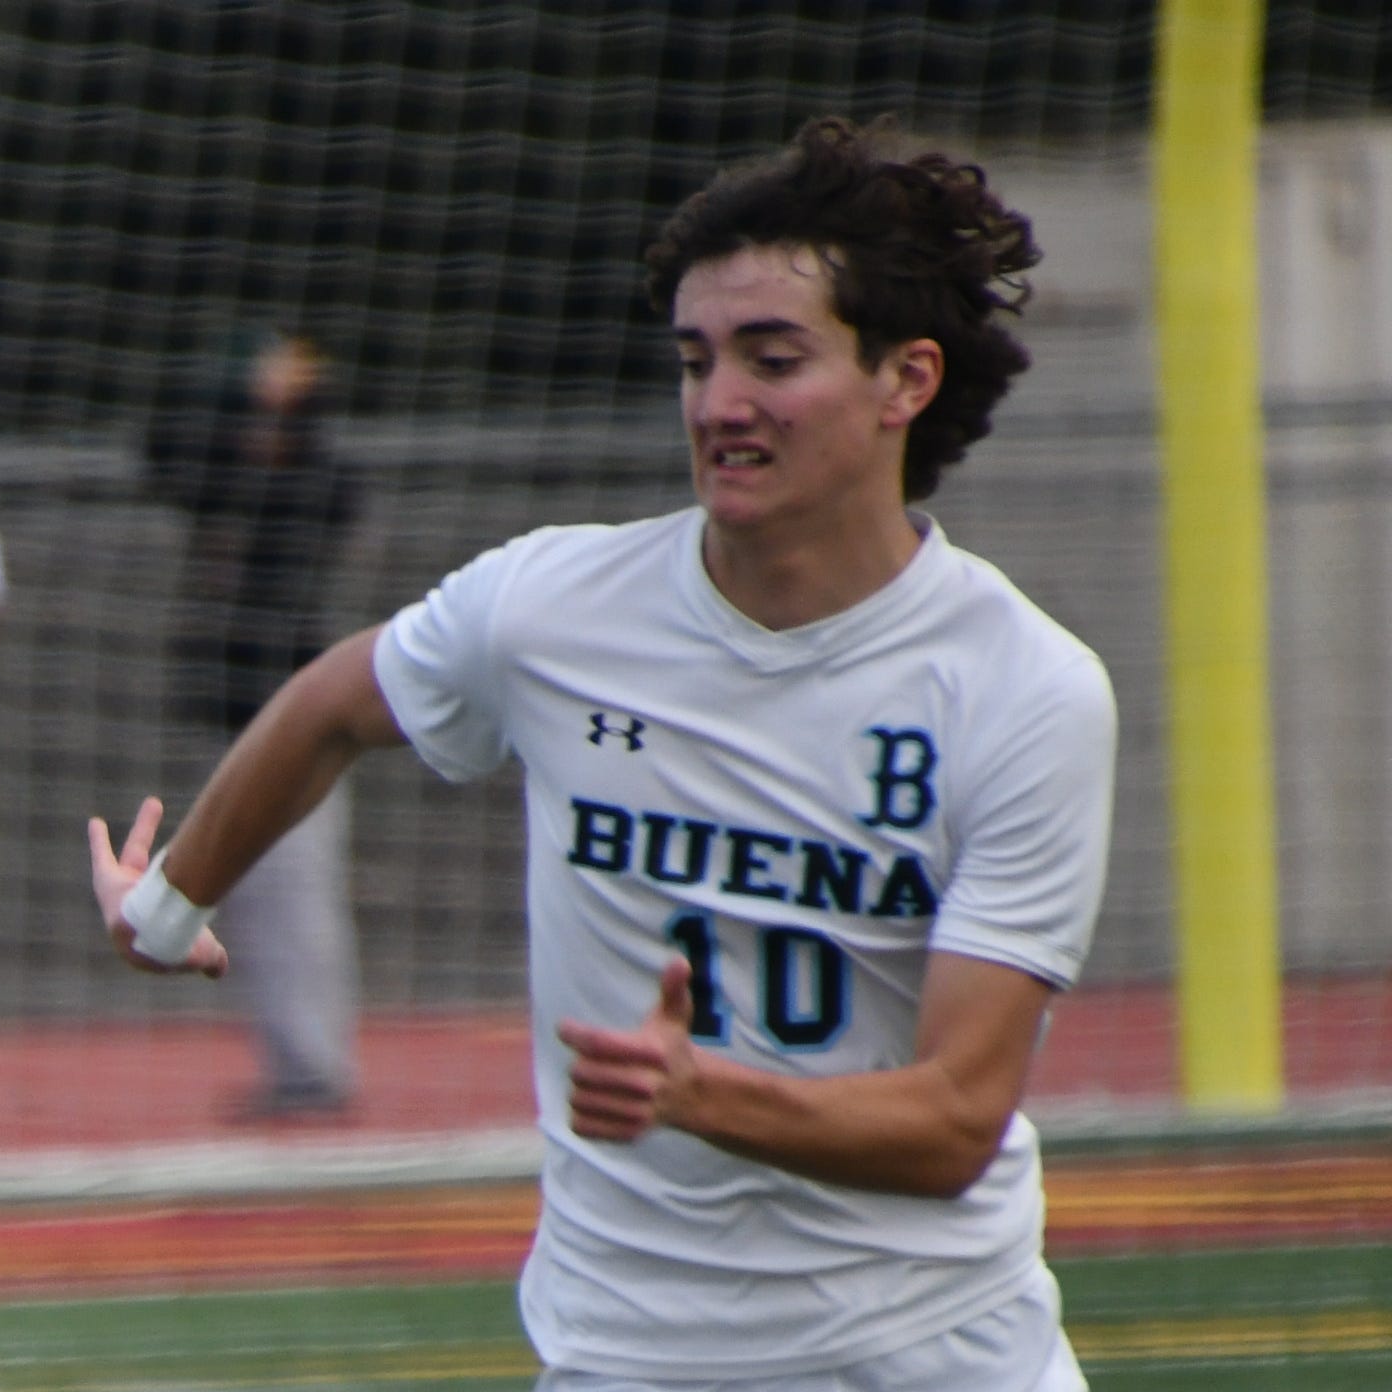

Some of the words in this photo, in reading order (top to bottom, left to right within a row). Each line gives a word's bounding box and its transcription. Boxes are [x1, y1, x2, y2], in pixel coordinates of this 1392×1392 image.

[857, 723, 938, 829] B
[568, 797, 940, 917] BUENA
[666, 908, 853, 1053] 10
